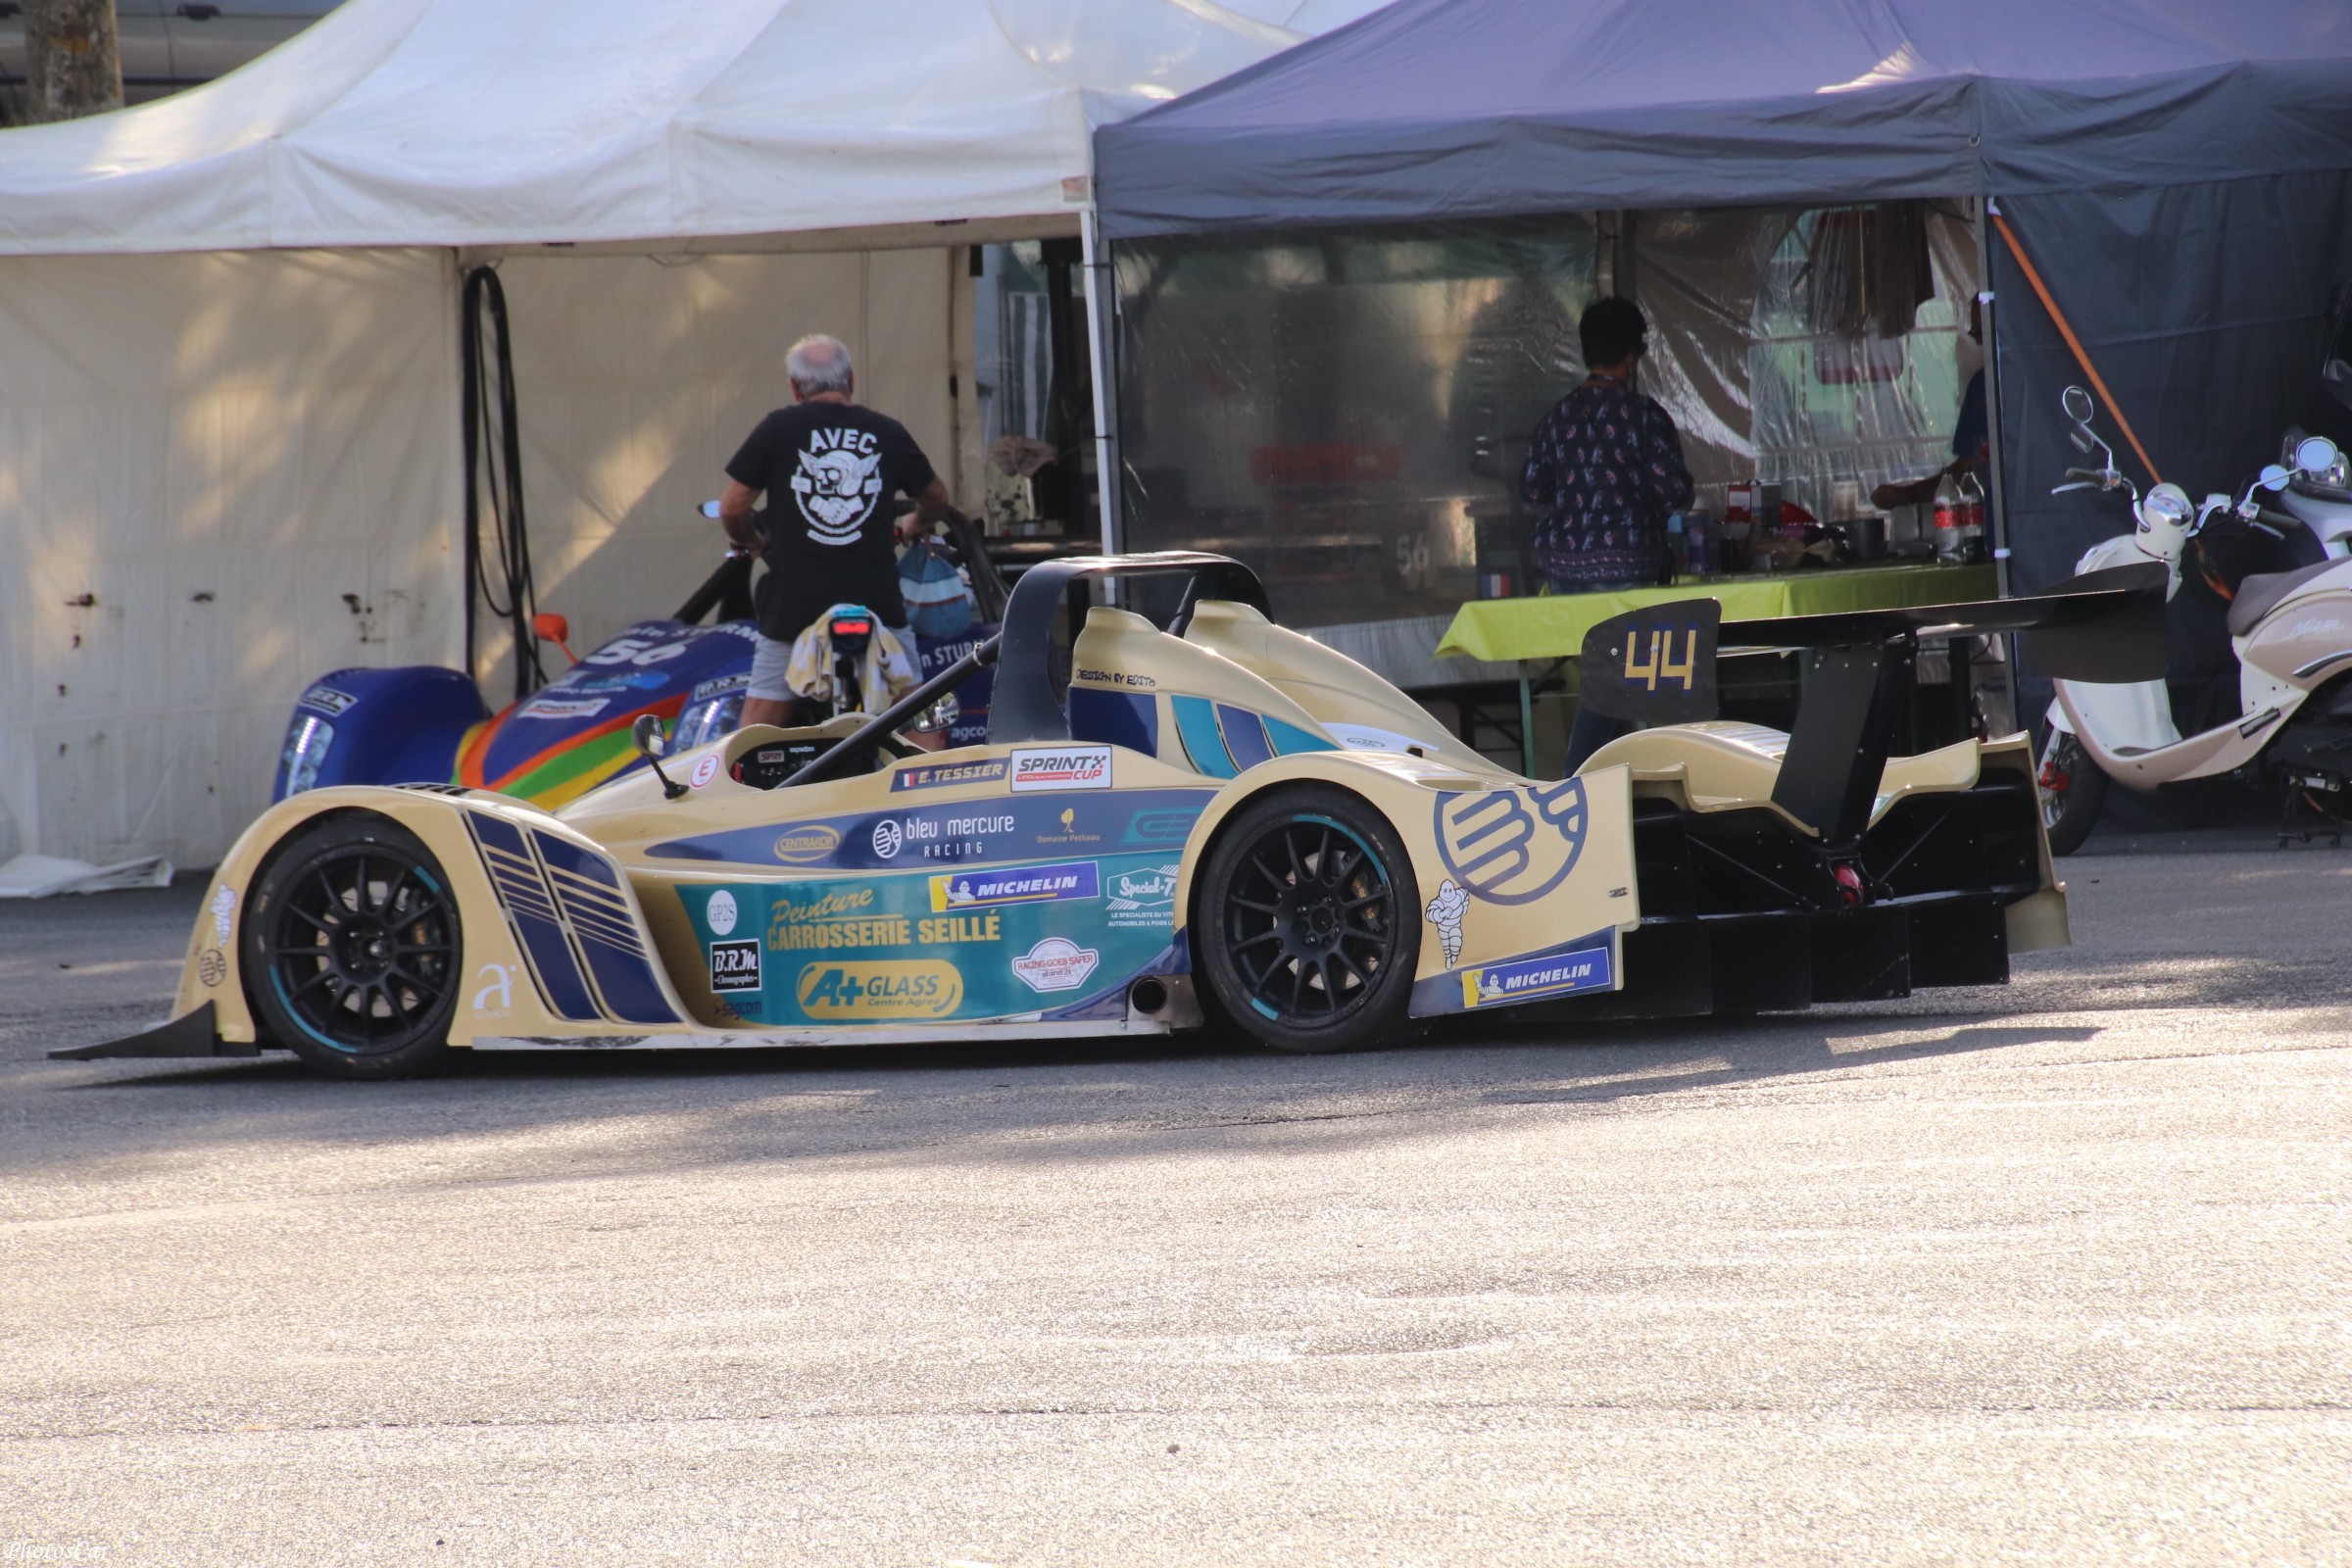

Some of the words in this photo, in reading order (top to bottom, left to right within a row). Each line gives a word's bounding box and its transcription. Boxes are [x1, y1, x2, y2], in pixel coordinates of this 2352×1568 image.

[810, 427, 877, 454] AVEC
[1624, 629, 1696, 691] 44
[1076, 668, 1111, 683] DESIGN
[1113, 672, 1125, 684] BY
[951, 725, 987, 742] agco
[699, 760, 711, 777] E
[1018, 756, 1093, 772] SPRINT
[917, 771, 931, 784] E.
[934, 763, 1004, 783] TESSIER
[1073, 769, 1102, 780] CUP
[906, 817, 938, 840] bleu
[948, 815, 1014, 836] mercure
[780, 835, 834, 852] CENTRAKOR
[1037, 835, 1068, 844] Domaine
[1069, 834, 1101, 843] Petiteau
[924, 842, 983, 858] RACING
[977, 874, 1078, 897] MICHELIN
[708, 903, 735, 922] GP2S
[770, 887, 874, 925] Peinture
[767, 919, 911, 952] CARROSSERIE
[917, 908, 1002, 944] SEILLÉ
[1017, 959, 1046, 970] RACING
[1047, 957, 1068, 967] GOES
[1068, 955, 1094, 965] SAFER
[1505, 962, 1592, 990] MICHELIN
[867, 975, 940, 997] GLASS
[868, 998, 904, 1006] Centre
